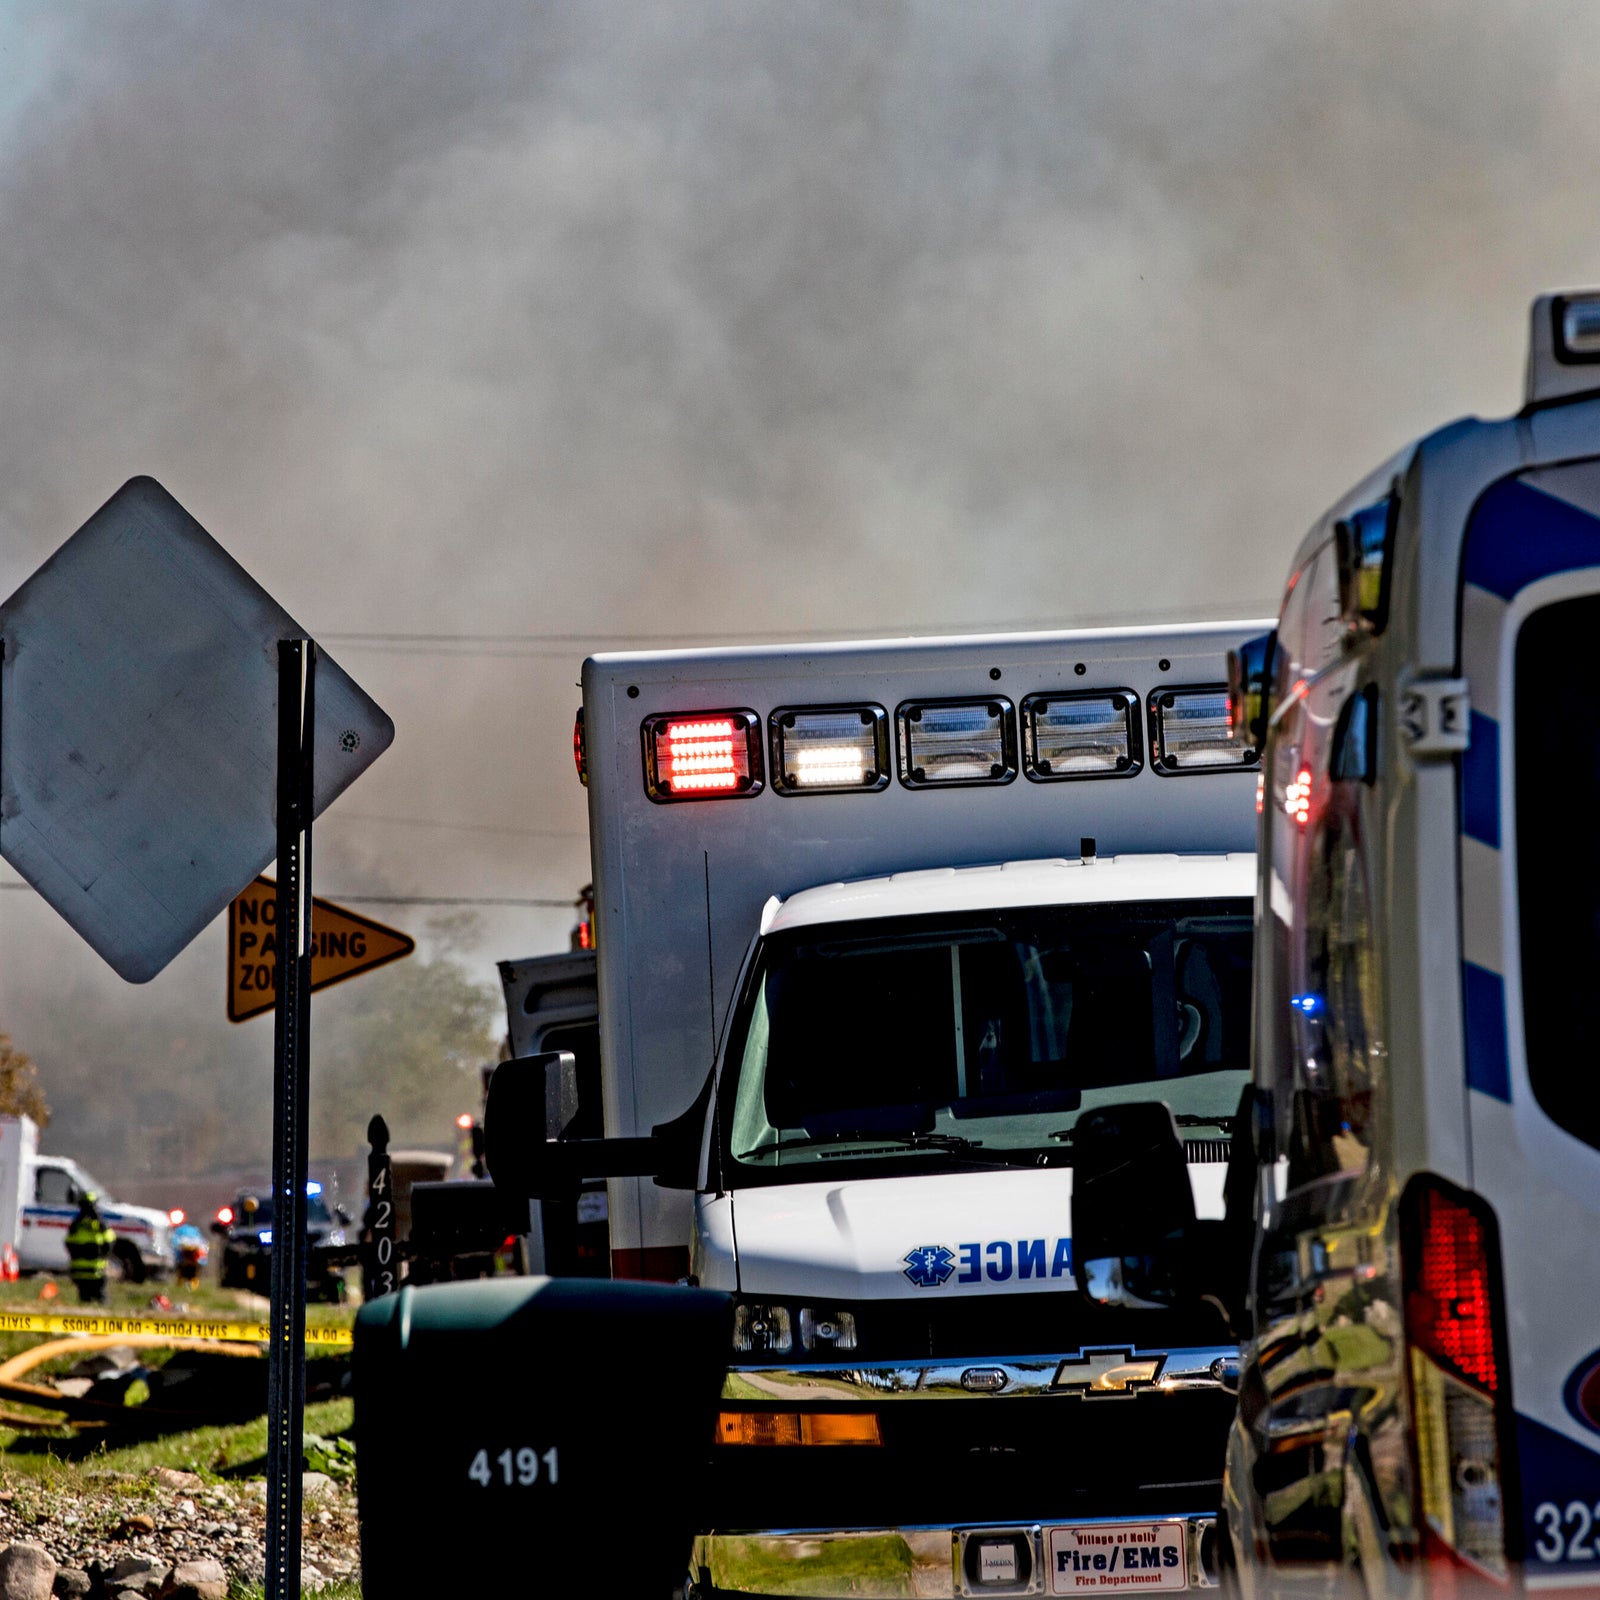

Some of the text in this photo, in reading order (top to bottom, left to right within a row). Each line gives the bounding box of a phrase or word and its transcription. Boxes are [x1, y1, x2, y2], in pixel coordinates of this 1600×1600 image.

[239, 898, 277, 926] NO
[239, 964, 277, 991] ZO
[372, 1167, 394, 1295] 4203
[62, 1318, 98, 1333] CROSS
[103, 1319, 123, 1333] NOT
[127, 1321, 142, 1334] DO
[153, 1322, 192, 1336] POLICE
[195, 1323, 228, 1337] STATE
[305, 1329, 319, 1341] NO
[322, 1329, 338, 1341] DO
[468, 1446, 559, 1487] 4191
[1076, 1531, 1157, 1546] Village of Holly
[1534, 1501, 1600, 1562] 32
[1057, 1545, 1179, 1573] Fire/EMS
[1075, 1573, 1162, 1587] Fire Department
